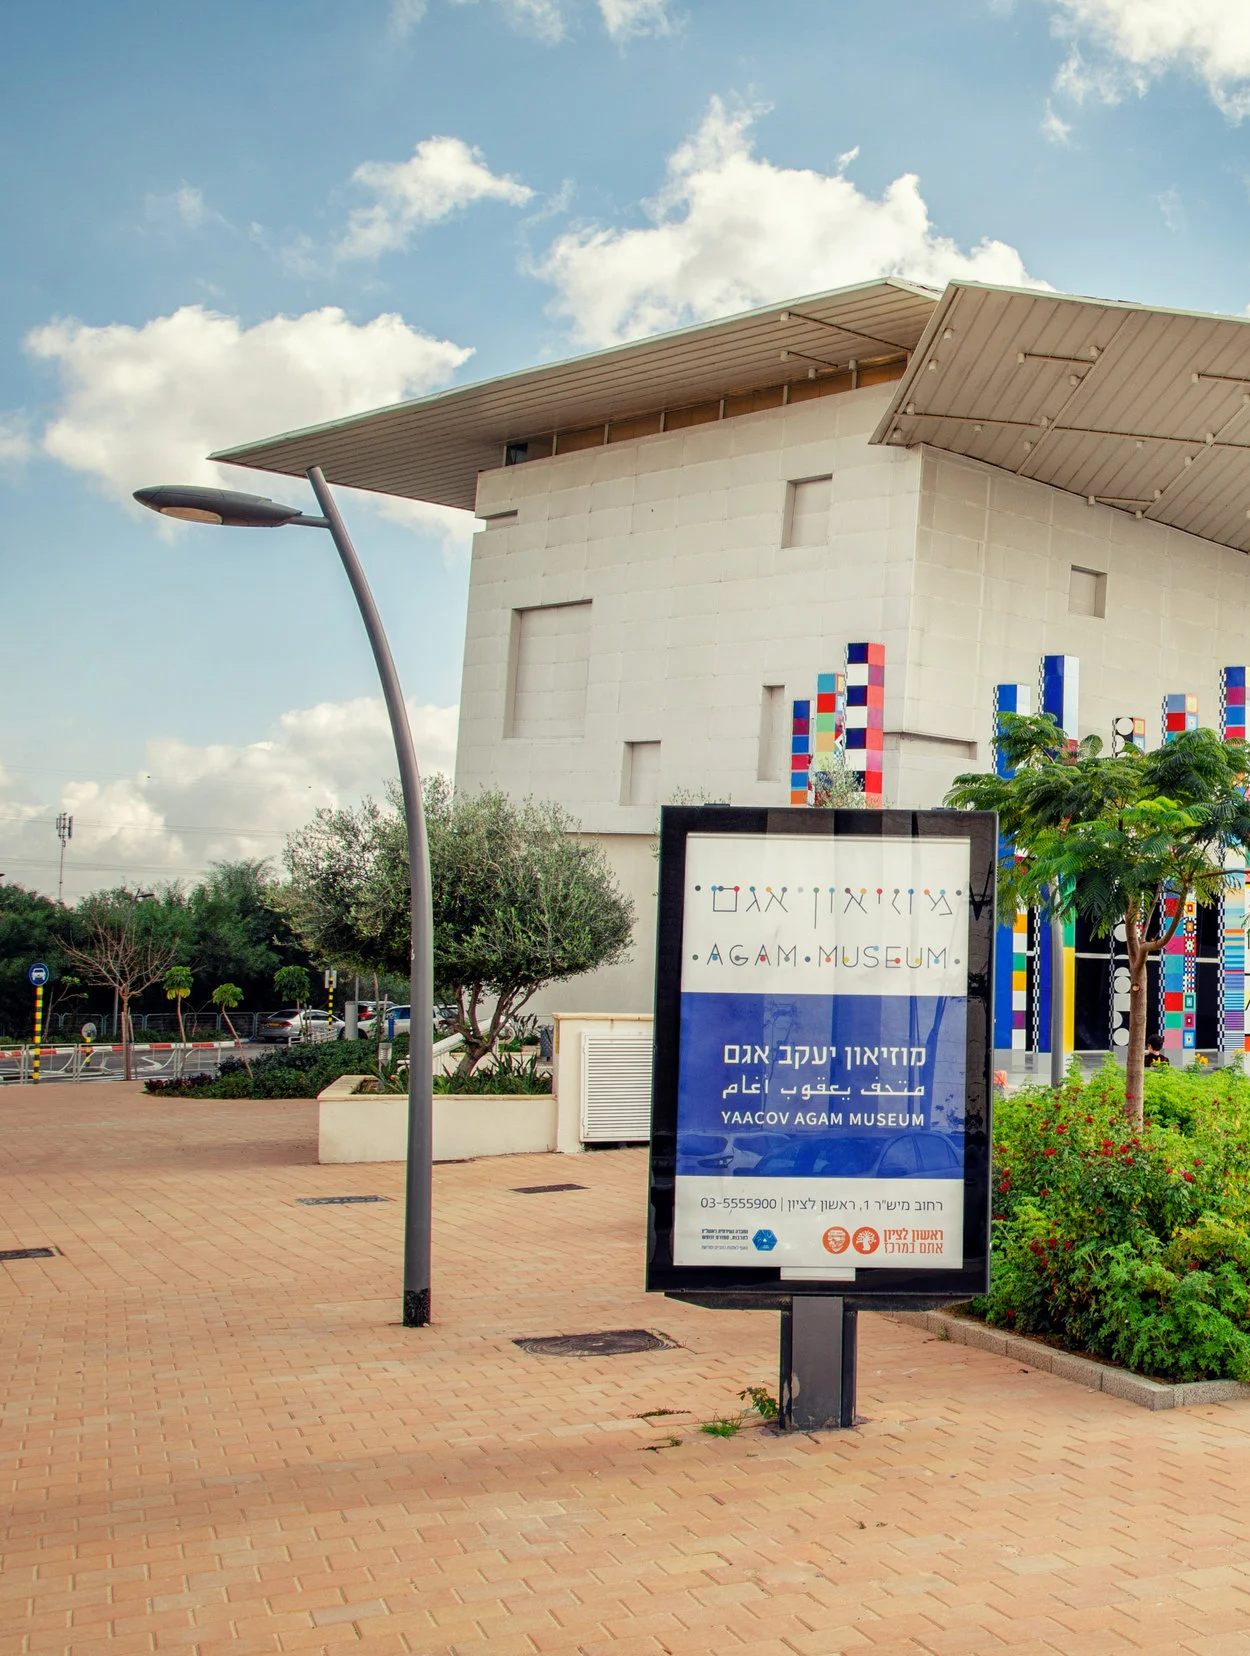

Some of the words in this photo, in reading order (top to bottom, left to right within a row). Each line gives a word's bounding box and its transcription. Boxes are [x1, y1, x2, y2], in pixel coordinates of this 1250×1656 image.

[710, 885, 789, 913] אגם
[812, 886, 953, 930] מוזיאון
[706, 943, 797, 967] AGAM
[818, 944, 947, 969] MUSEUM
[723, 1044, 770, 1065] אגם
[778, 1045, 836, 1070] יעקב
[844, 1045, 927, 1071] מוזיאון
[780, 1076, 851, 1101] يعقوب
[860, 1075, 925, 1096] متحف
[720, 1111, 790, 1125] YAACOV
[794, 1112, 843, 1126] AGAM
[849, 1113, 925, 1127] MUSEUM
[700, 1197, 777, 1209] 03-5555900
[787, 1197, 816, 1213] לציון
[820, 1199, 856, 1213] ראשון
[914, 1200, 943, 1211] רחוב
[883, 1227, 909, 1243] לציון
[911, 1229, 944, 1243] ראשון
[883, 1242, 915, 1254] במרכז
[919, 1242, 944, 1254] אתם
